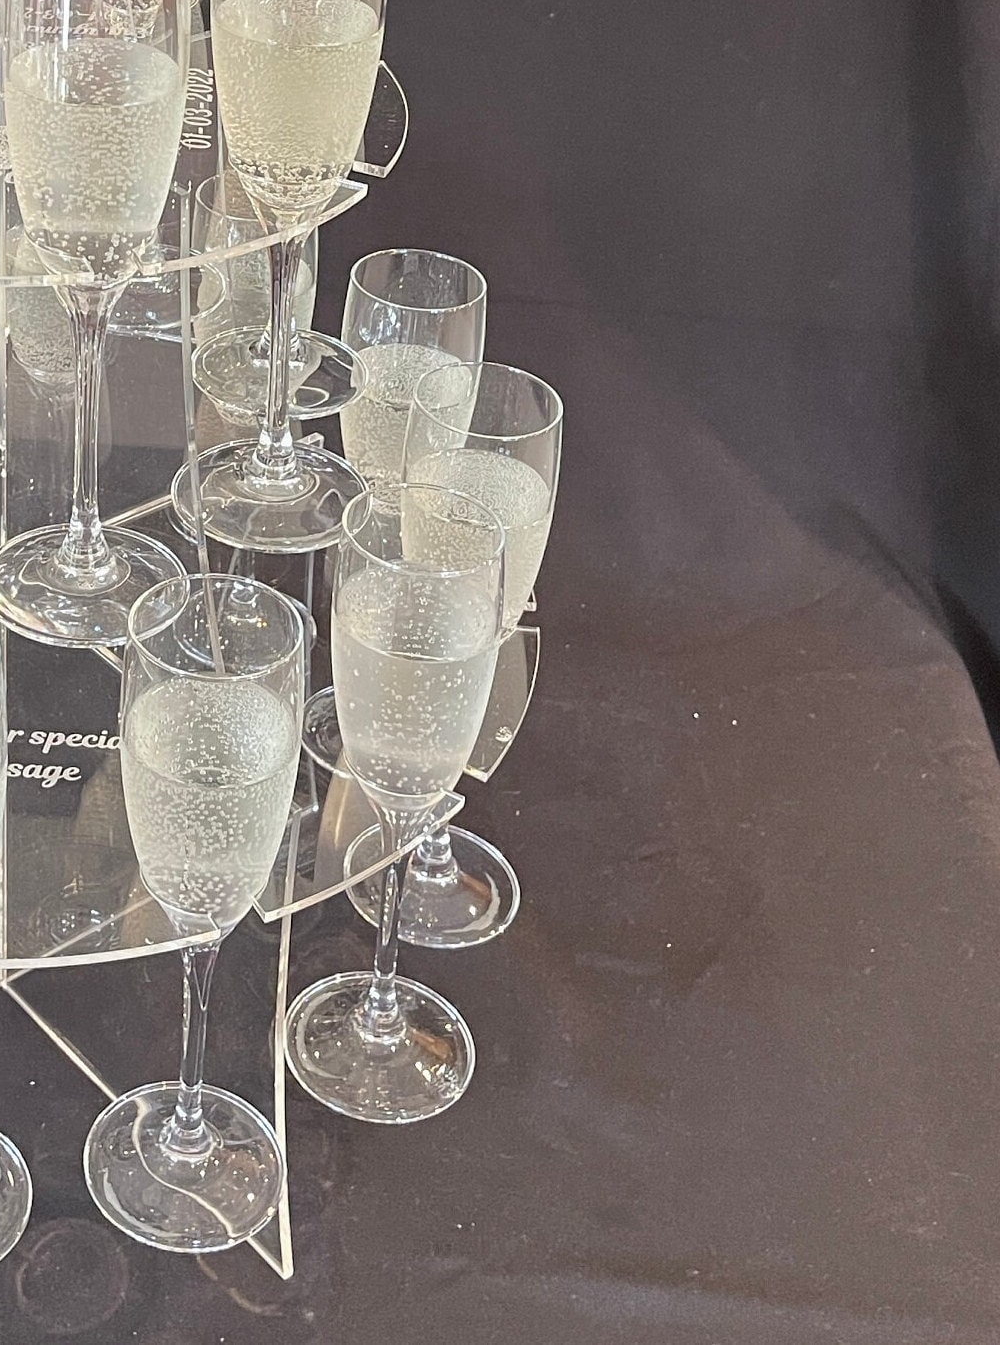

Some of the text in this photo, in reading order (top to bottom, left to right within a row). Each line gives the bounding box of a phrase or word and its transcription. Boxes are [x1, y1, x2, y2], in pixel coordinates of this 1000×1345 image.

[181, 67, 213, 150] 01-03-2022
[28, 729, 121, 754] specia
[7, 762, 82, 789] sage
